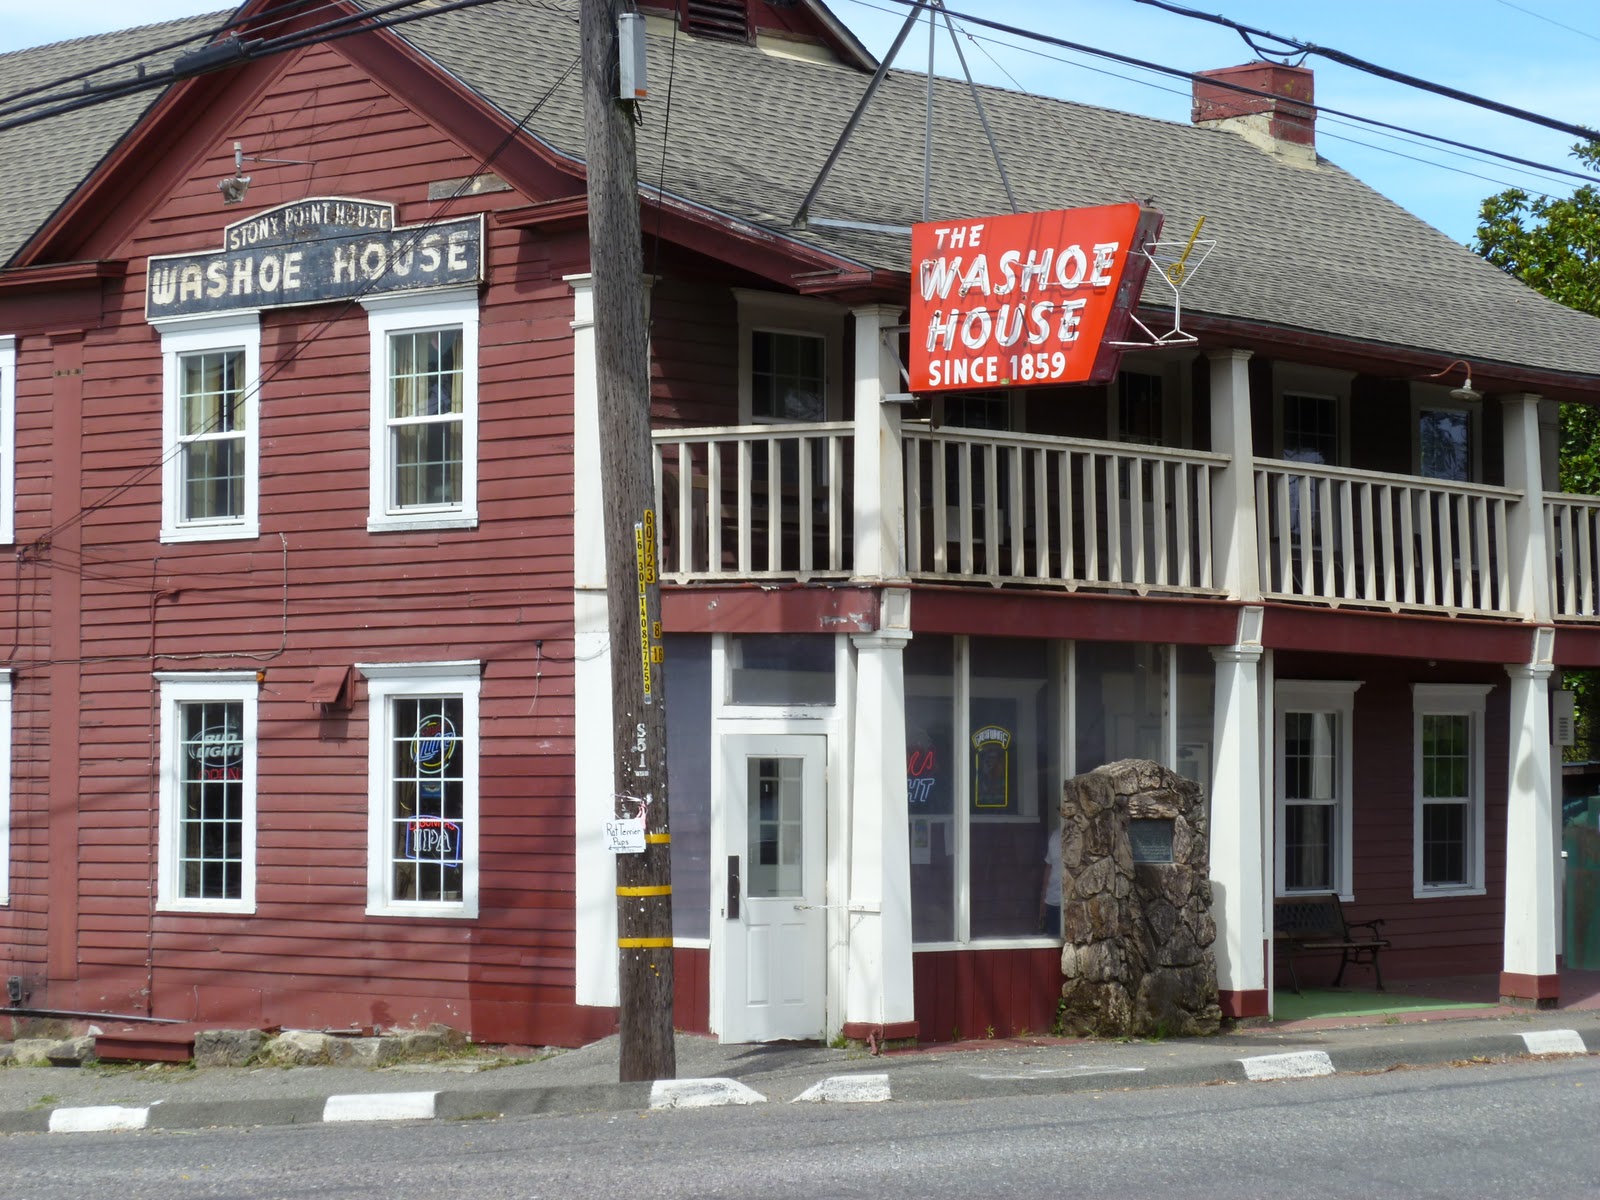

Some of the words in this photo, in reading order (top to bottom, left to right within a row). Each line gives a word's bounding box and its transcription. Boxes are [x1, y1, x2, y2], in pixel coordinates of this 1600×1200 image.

[230, 216, 279, 251] STONY
[285, 202, 331, 230] POINT
[335, 202, 391, 229] HOUSE
[934, 224, 985, 250] THE
[151, 250, 303, 305] WASHOE
[332, 230, 470, 285] HOUSE
[919, 241, 1120, 301] WASHOE
[926, 298, 1088, 353] HOUSE
[928, 355, 998, 387] SINCE
[1009, 352, 1066, 381] 1859
[645, 511, 654, 582] 60723
[653, 623, 660, 638] 8
[652, 647, 663, 661] 16
[203, 731, 239, 746] BUD
[196, 744, 243, 759] LIGHT
[197, 766, 242, 781] OPEN
[409, 816, 456, 831] LGUNIAS
[606, 822, 618, 837] Rat
[618, 823, 641, 836] Terrier
[413, 828, 452, 852] IPA
[612, 836, 630, 847] Pups
